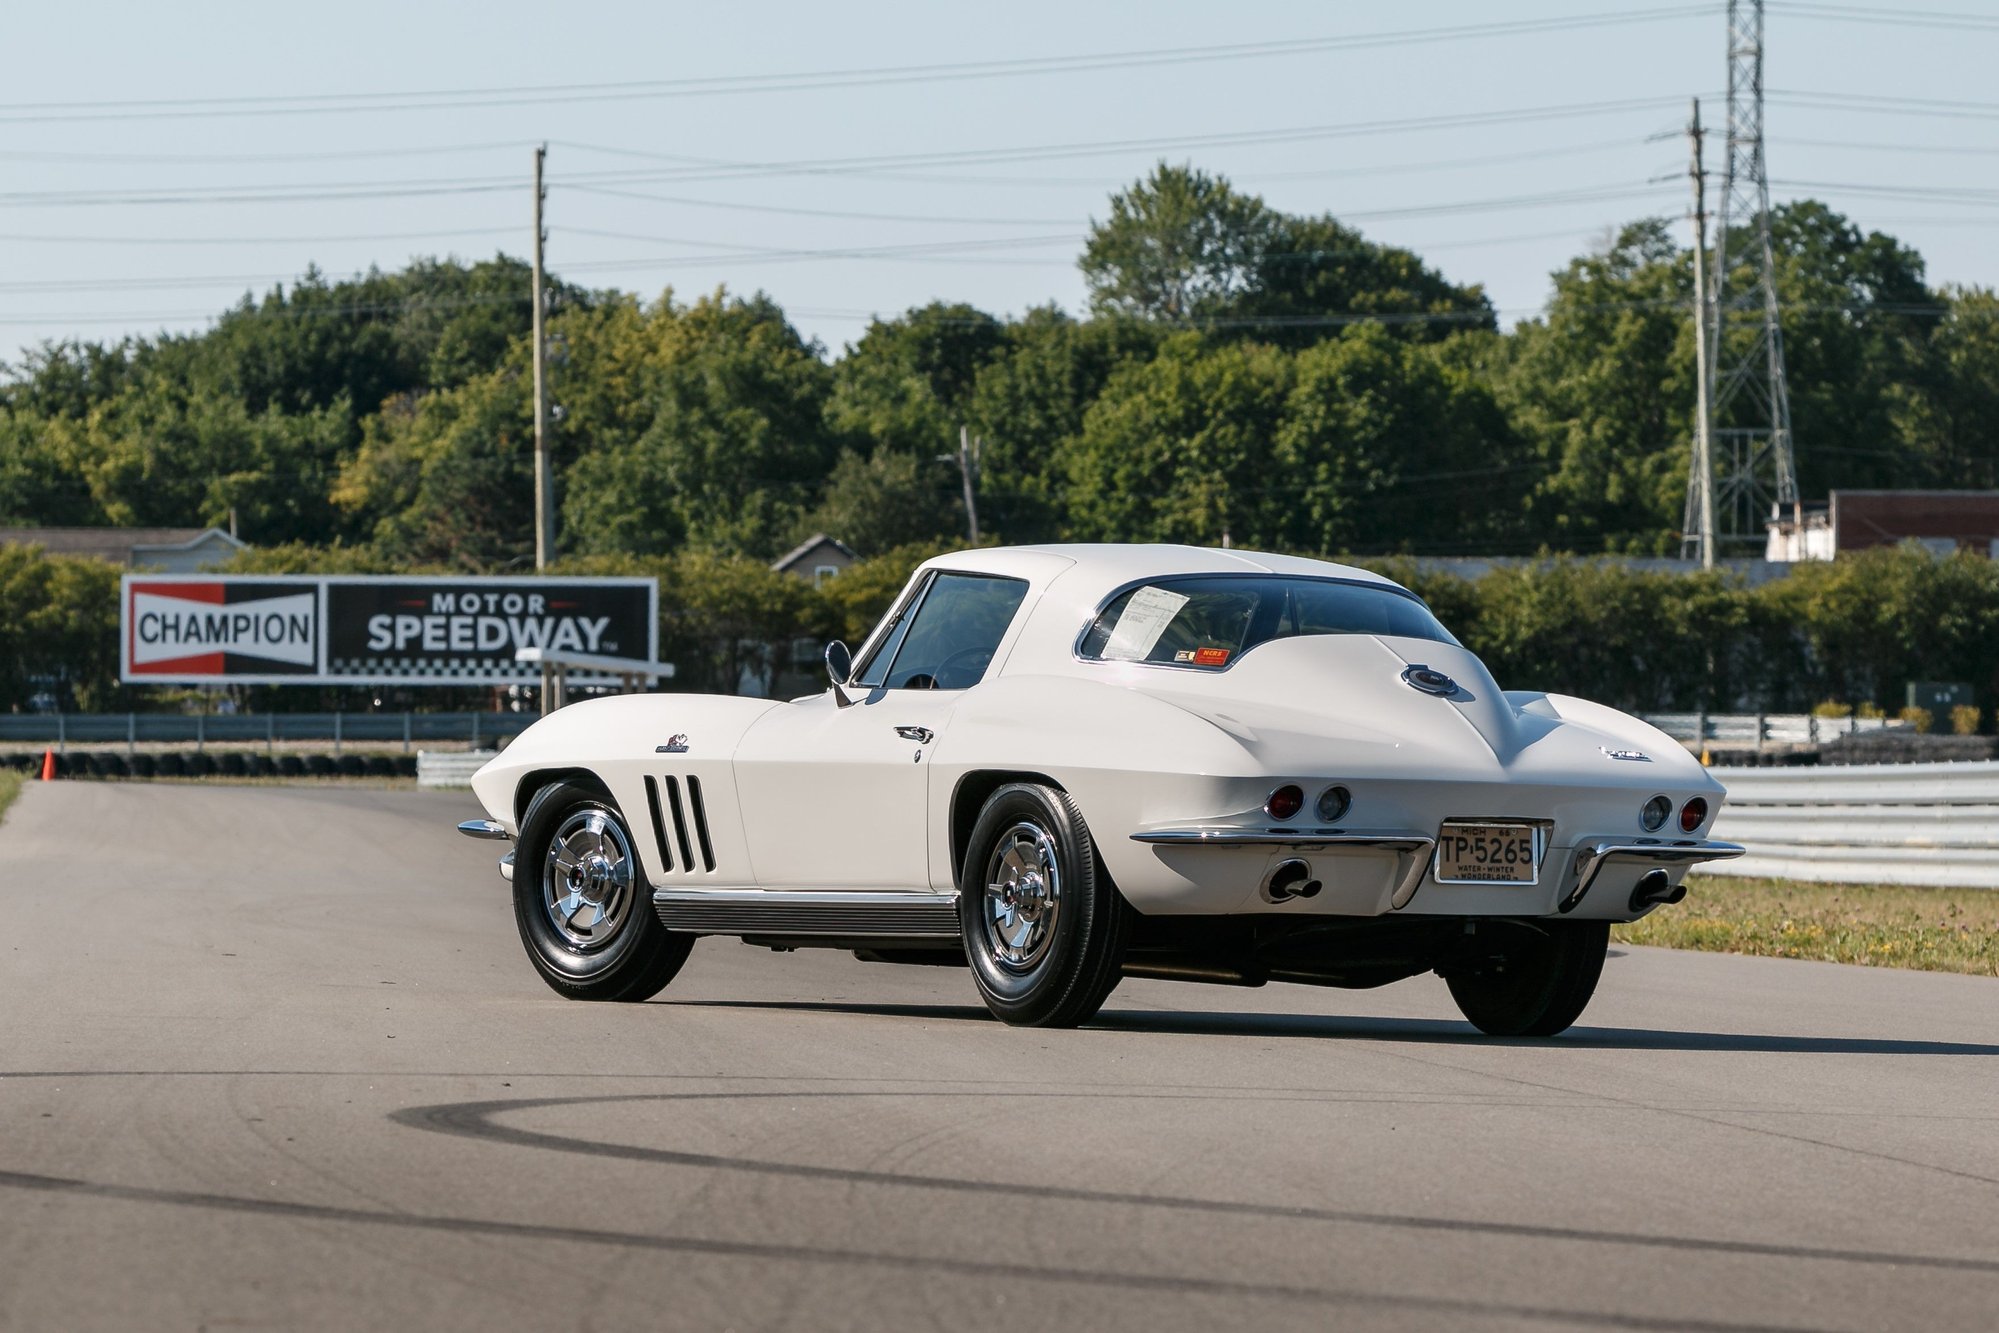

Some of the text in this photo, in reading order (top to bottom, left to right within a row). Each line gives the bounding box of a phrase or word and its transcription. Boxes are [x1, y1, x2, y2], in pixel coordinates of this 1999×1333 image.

[432, 593, 545, 615] MOTOR
[139, 613, 309, 644] CHAMPION
[367, 614, 611, 652] SPEEDWAY
